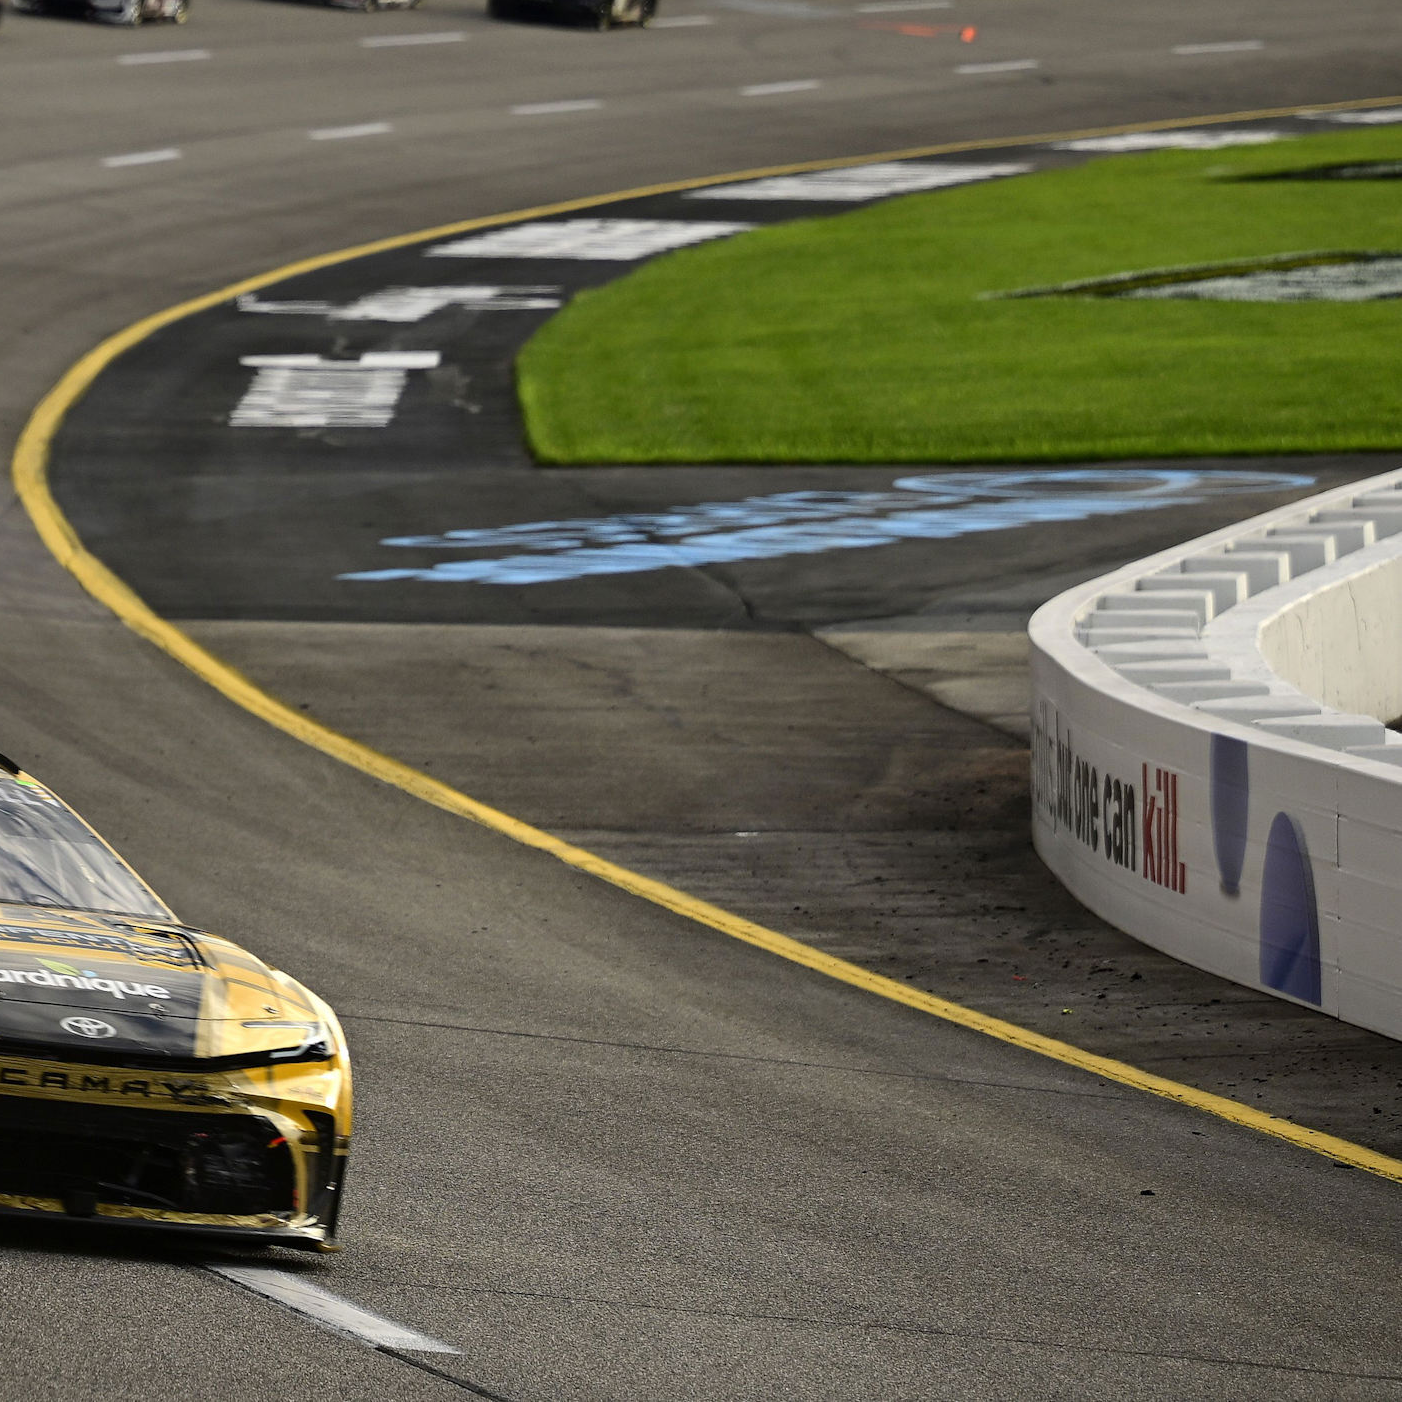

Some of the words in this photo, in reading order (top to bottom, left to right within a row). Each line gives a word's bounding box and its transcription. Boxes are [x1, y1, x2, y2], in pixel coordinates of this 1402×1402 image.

[1074, 754, 1099, 853] one
[1103, 773, 1136, 873] can
[1141, 762, 1186, 895] kill.
